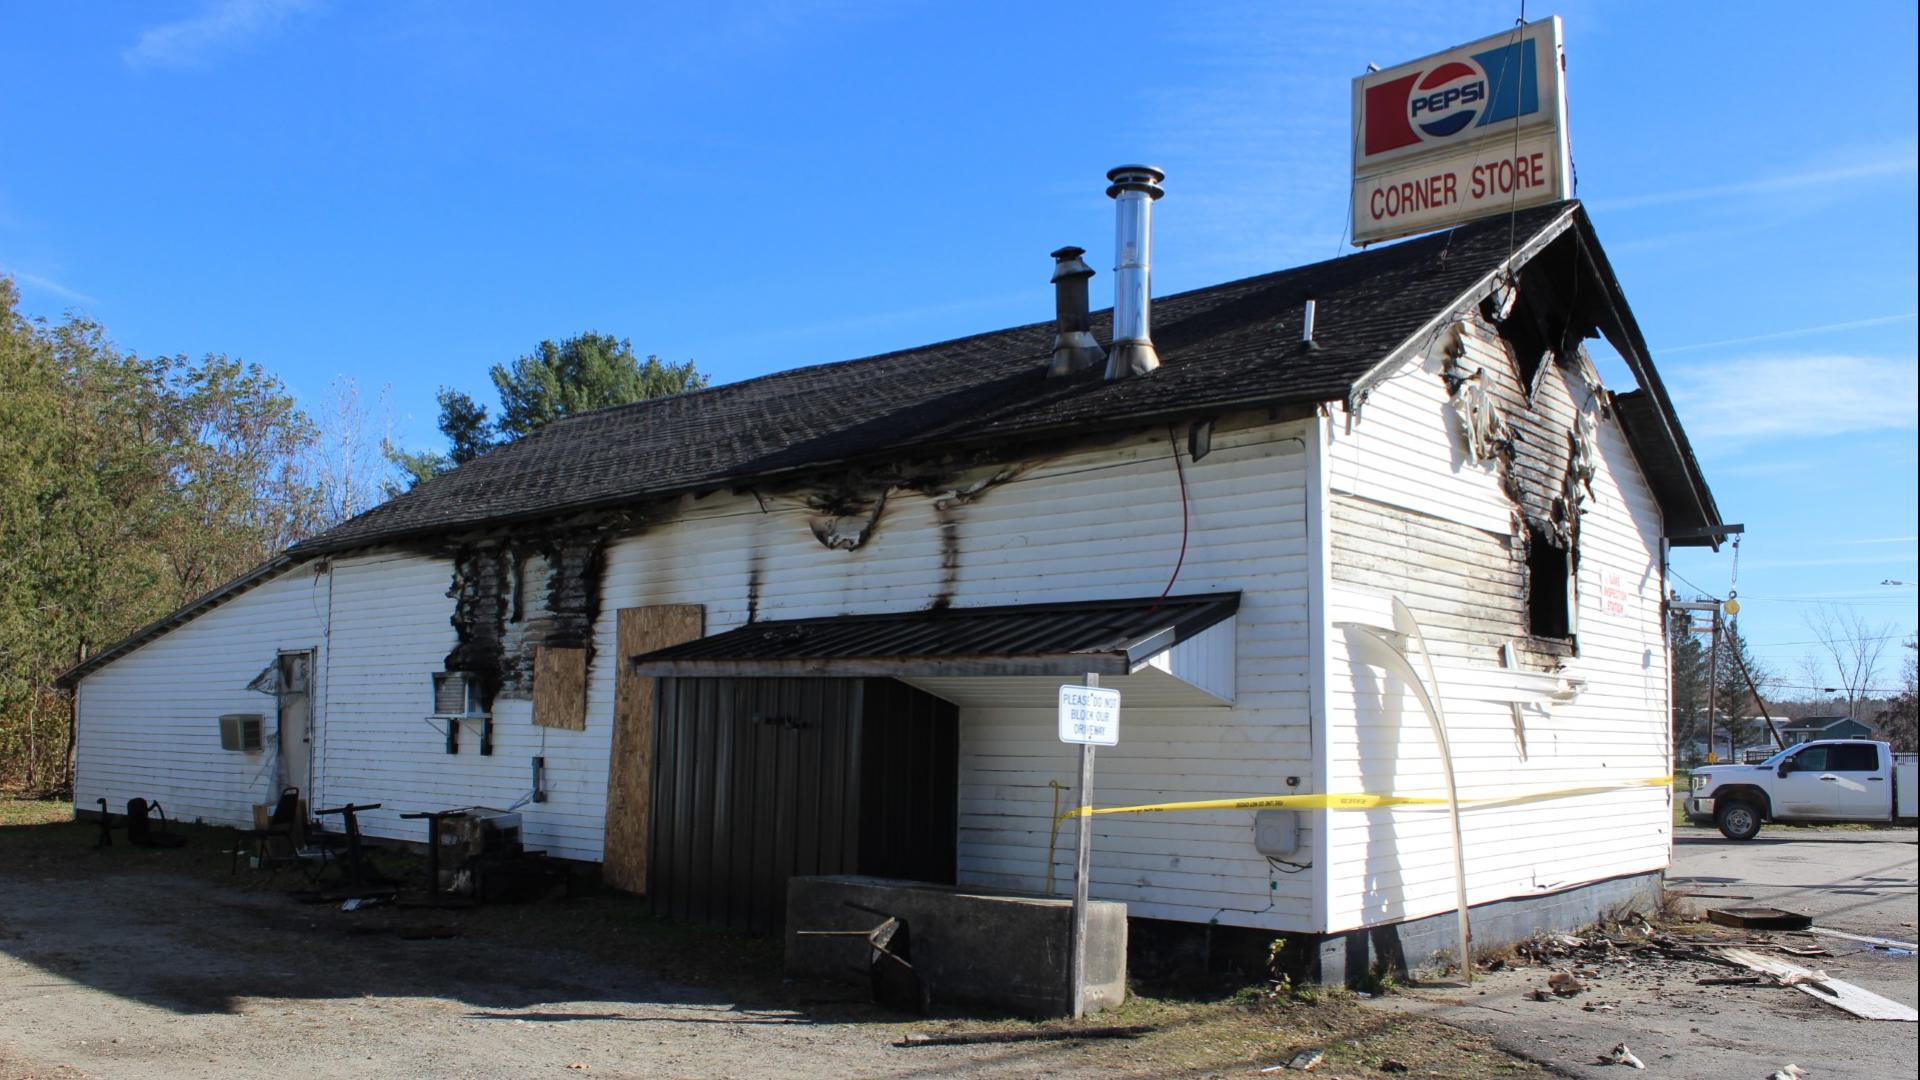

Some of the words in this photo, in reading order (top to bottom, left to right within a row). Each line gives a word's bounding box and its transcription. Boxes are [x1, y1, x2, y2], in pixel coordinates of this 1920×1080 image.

[1411, 79, 1485, 118] PEPSI
[1370, 172, 1458, 220] CORNER
[1471, 152, 1545, 199] STORE
[1063, 694, 1090, 707] PLEASE
[1093, 696, 1102, 707] DO
[1104, 698, 1116, 708] NOT
[1071, 709, 1094, 720] BLOCK
